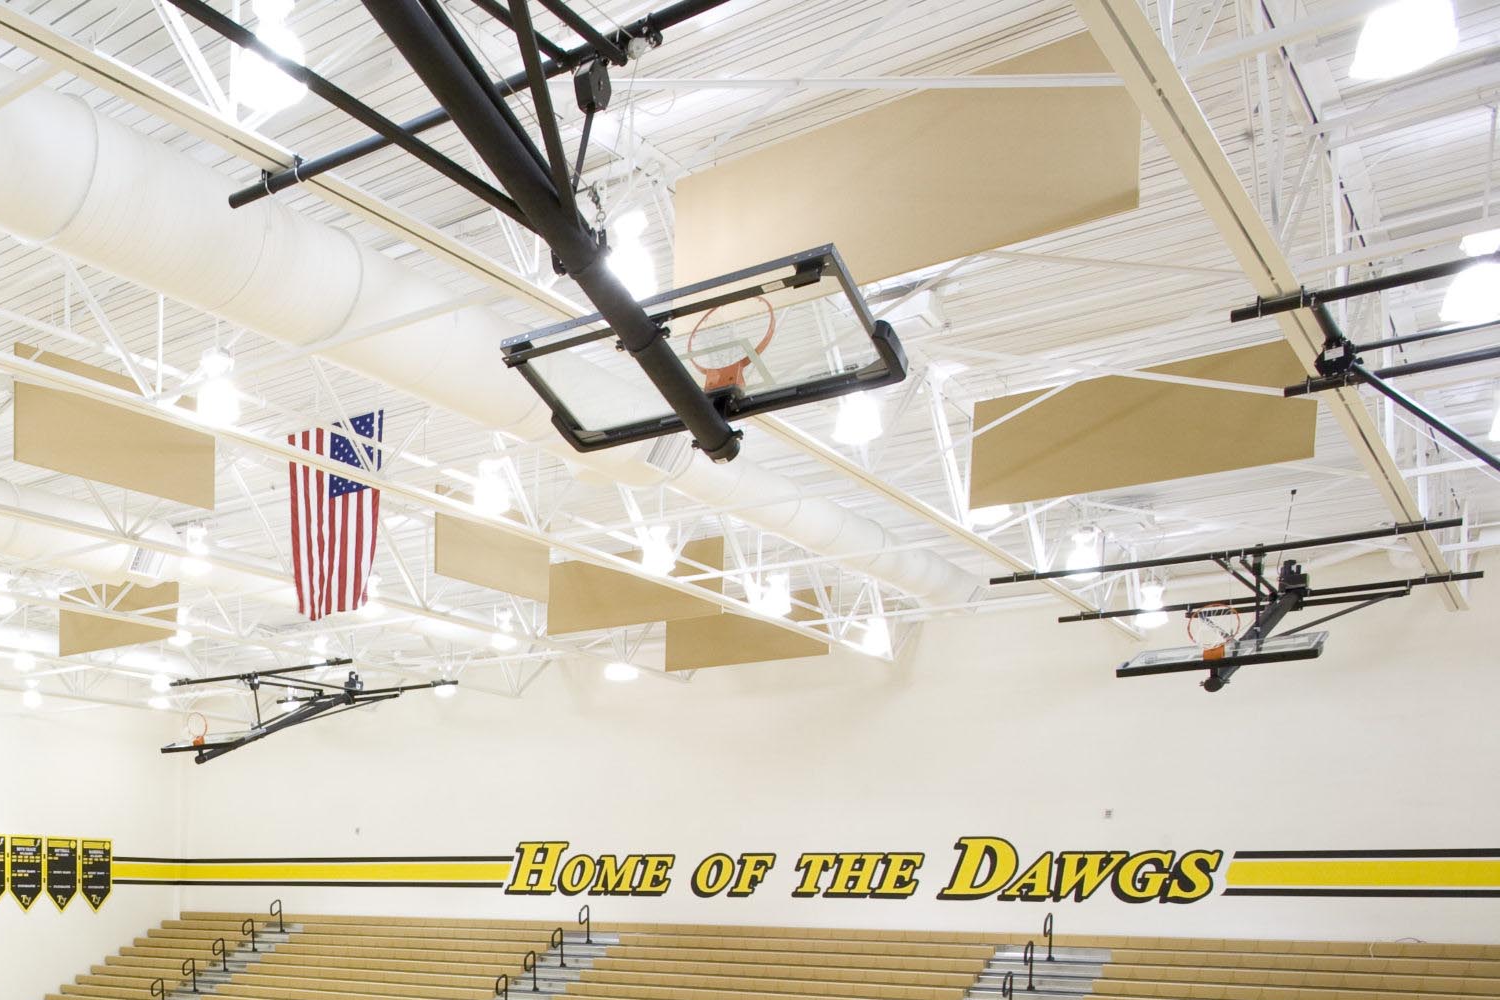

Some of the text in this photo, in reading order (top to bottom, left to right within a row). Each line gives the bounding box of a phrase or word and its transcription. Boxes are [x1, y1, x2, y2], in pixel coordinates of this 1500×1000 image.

[504, 834, 1224, 902] HOME OF THE DAWGS
